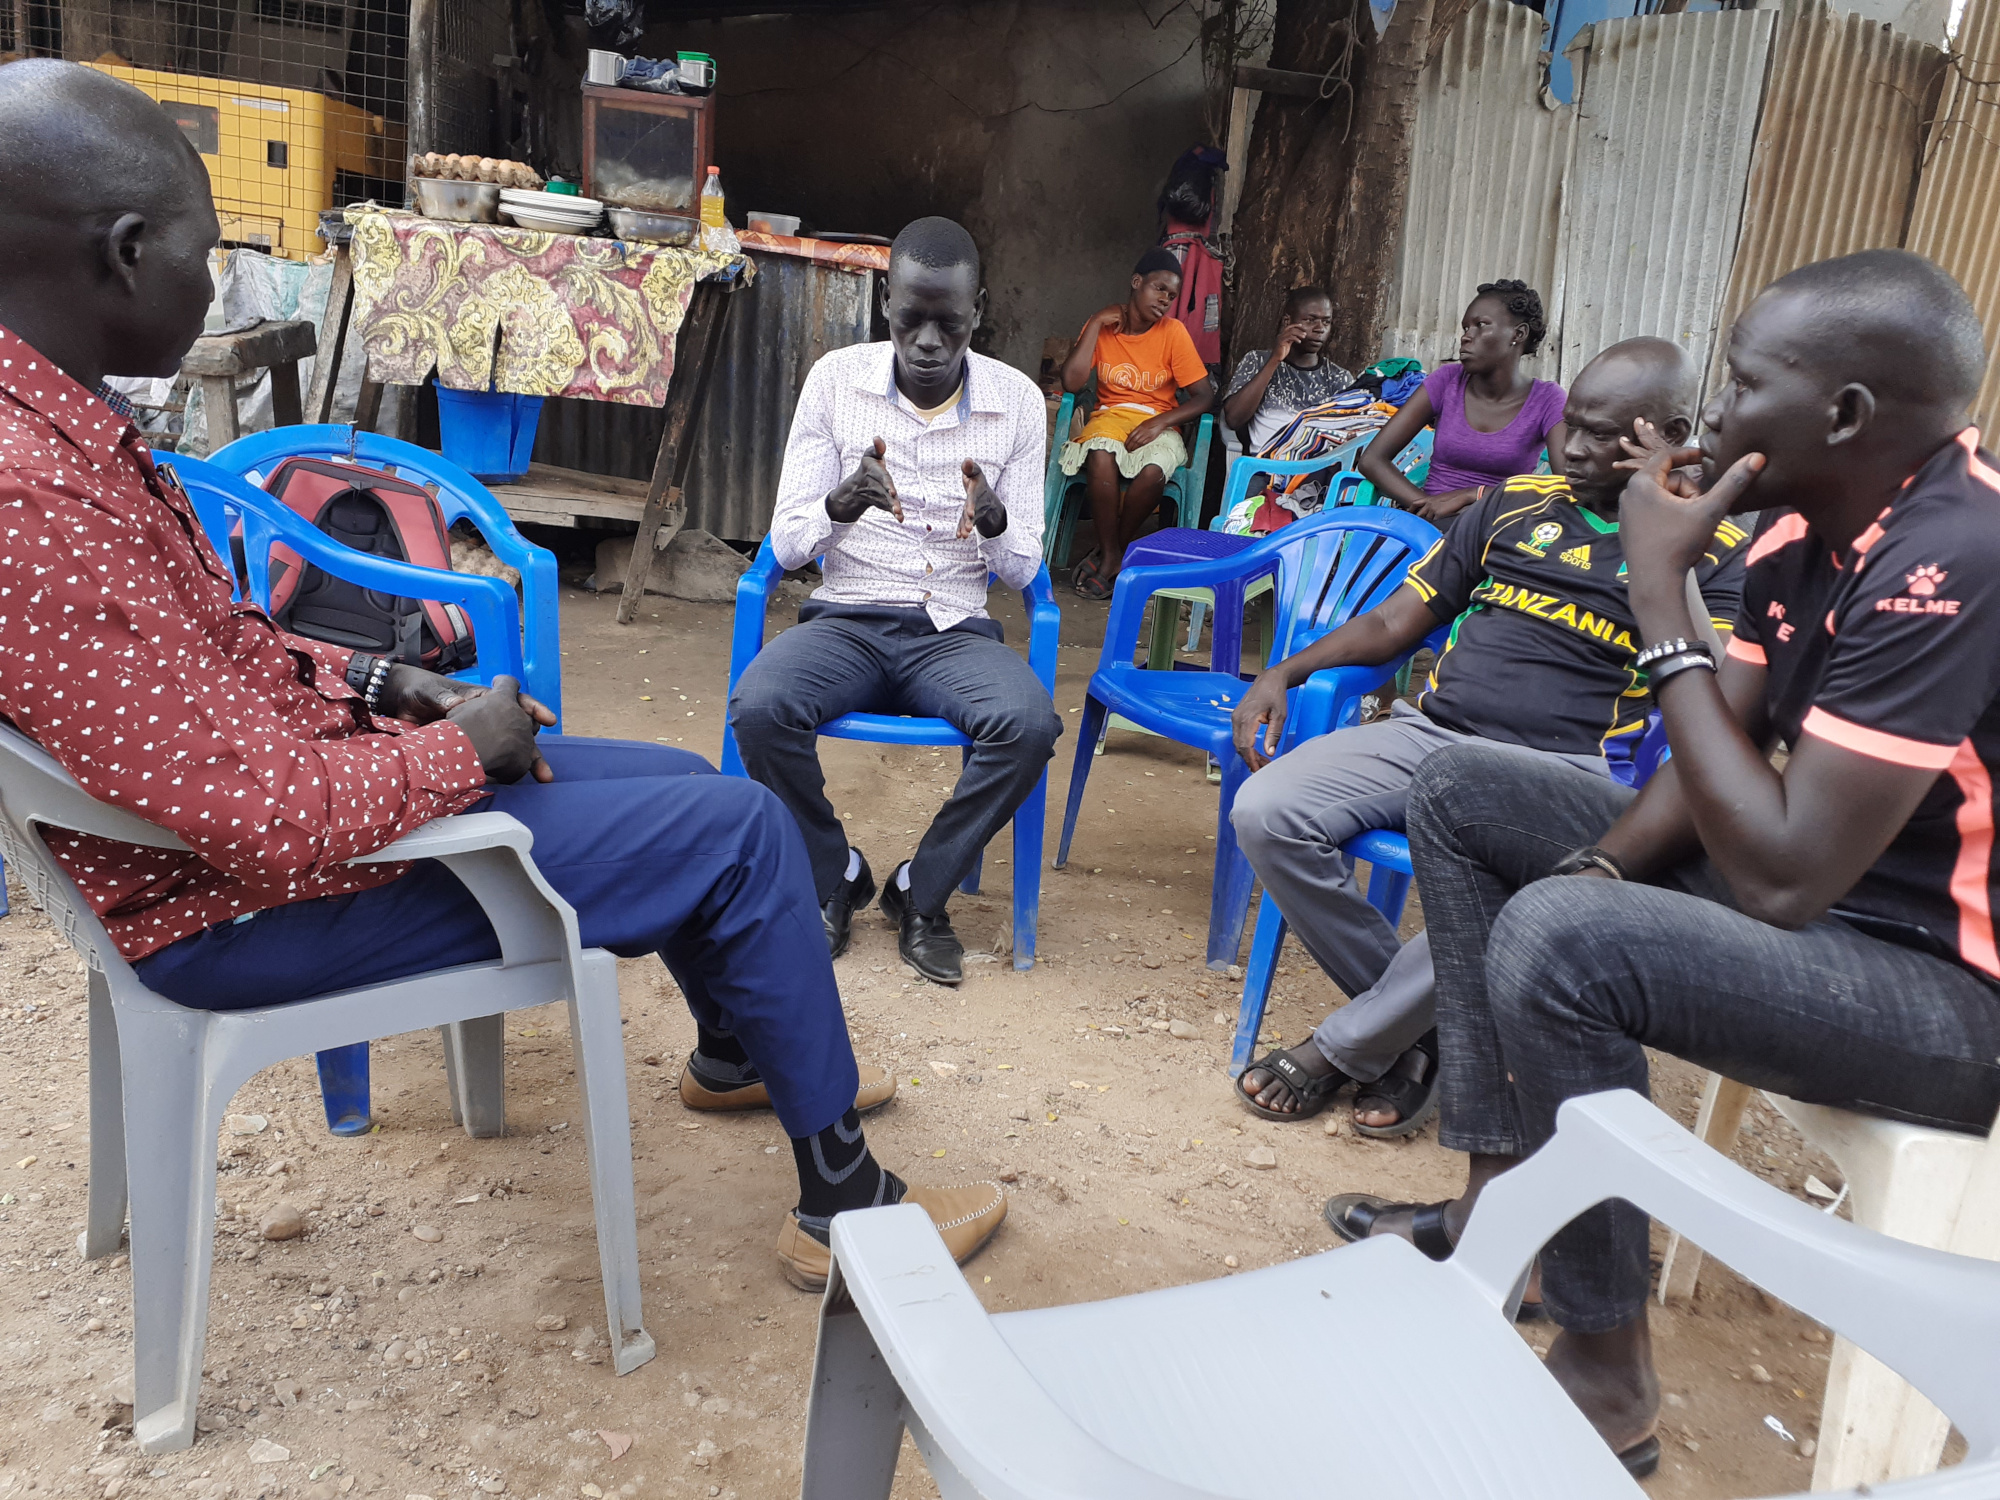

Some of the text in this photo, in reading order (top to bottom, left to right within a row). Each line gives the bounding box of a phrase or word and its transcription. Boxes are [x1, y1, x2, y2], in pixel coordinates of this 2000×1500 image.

[1875, 598, 1962, 615] KELME
[1480, 583, 1638, 653] TANZANIA
[1278, 1058, 1297, 1075] GHT
